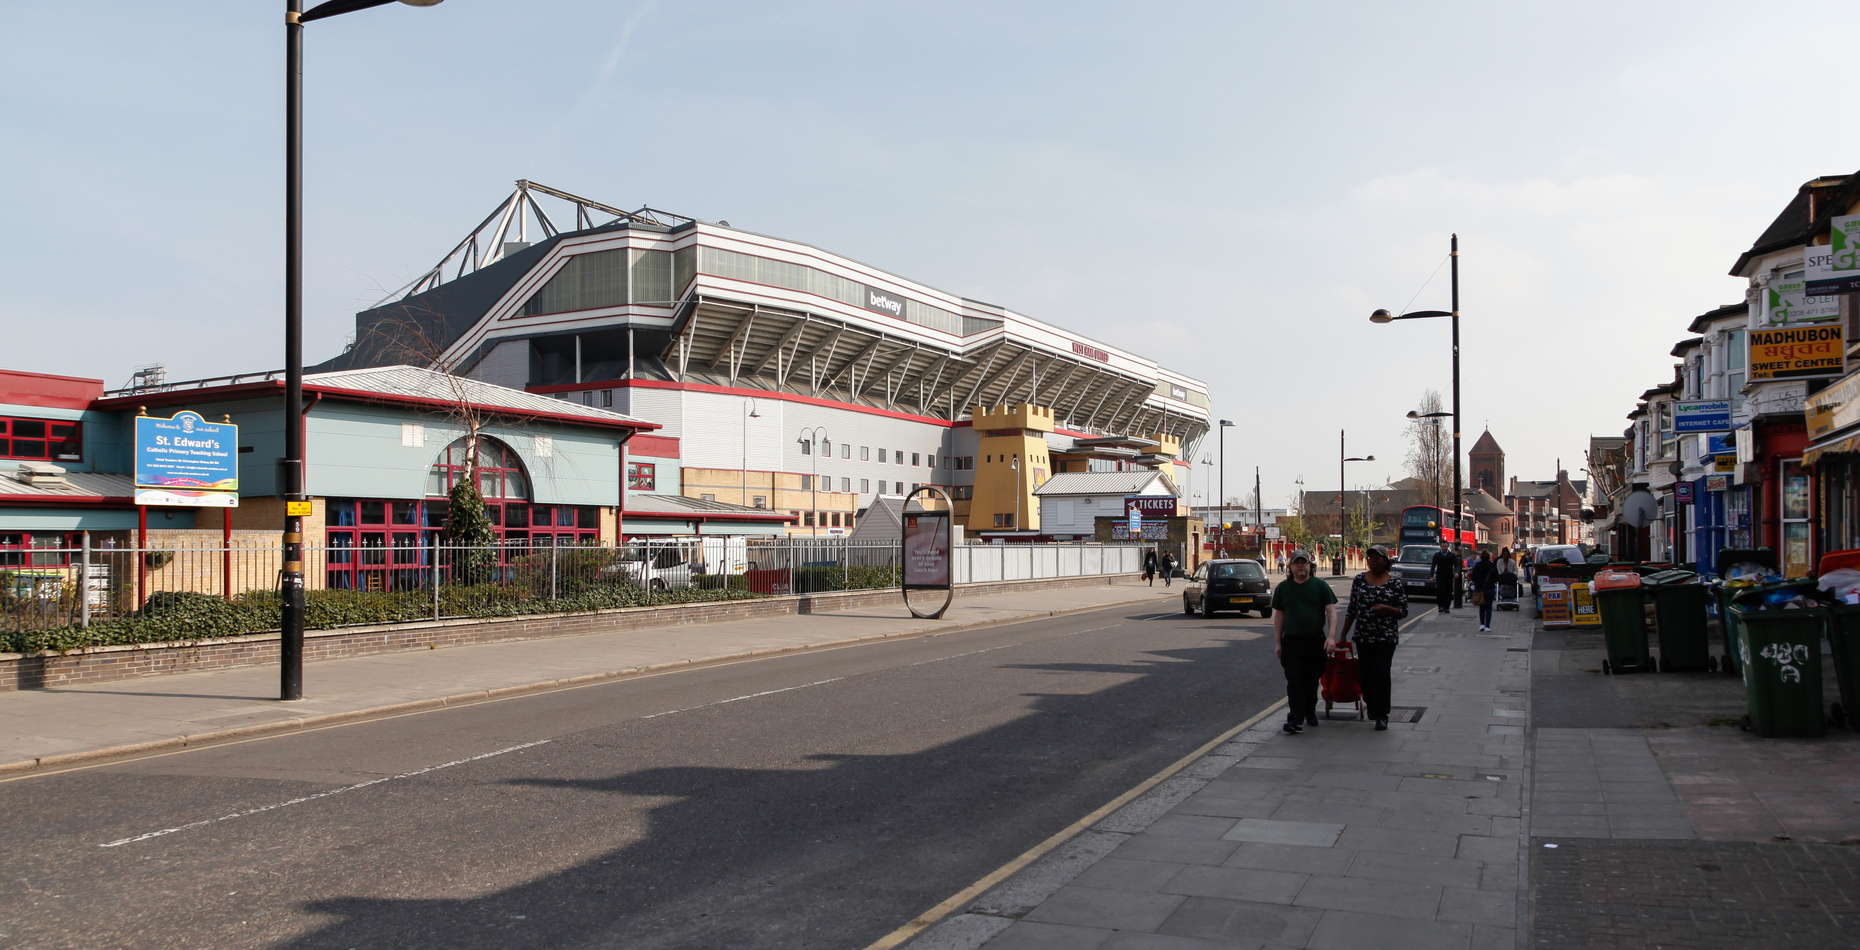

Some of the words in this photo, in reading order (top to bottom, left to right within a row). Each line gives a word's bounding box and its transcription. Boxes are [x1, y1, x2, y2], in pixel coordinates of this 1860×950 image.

[870, 291, 902, 316] betway
[1801, 297, 1816, 305] TO
[1819, 295, 1835, 304] LET
[1820, 306, 1839, 314] 8786
[1750, 327, 1841, 346] MADHUBON
[1072, 341, 1084, 355] WEST
[1084, 346, 1095, 358] HAM
[1094, 349, 1109, 363] UNITED
[1751, 361, 1791, 371] SWEET
[1795, 357, 1843, 368] CENTRE
[1815, 380, 1860, 416] MADHUBO
[1678, 402, 1729, 412] Lycamobile
[156, 436, 171, 446] St.
[174, 437, 220, 449] Edward's
[169, 448, 189, 456] Primary
[1138, 499, 1174, 509] TICKETS
[1548, 592, 1562, 600] PAK
[1578, 605, 1594, 614] HERE
